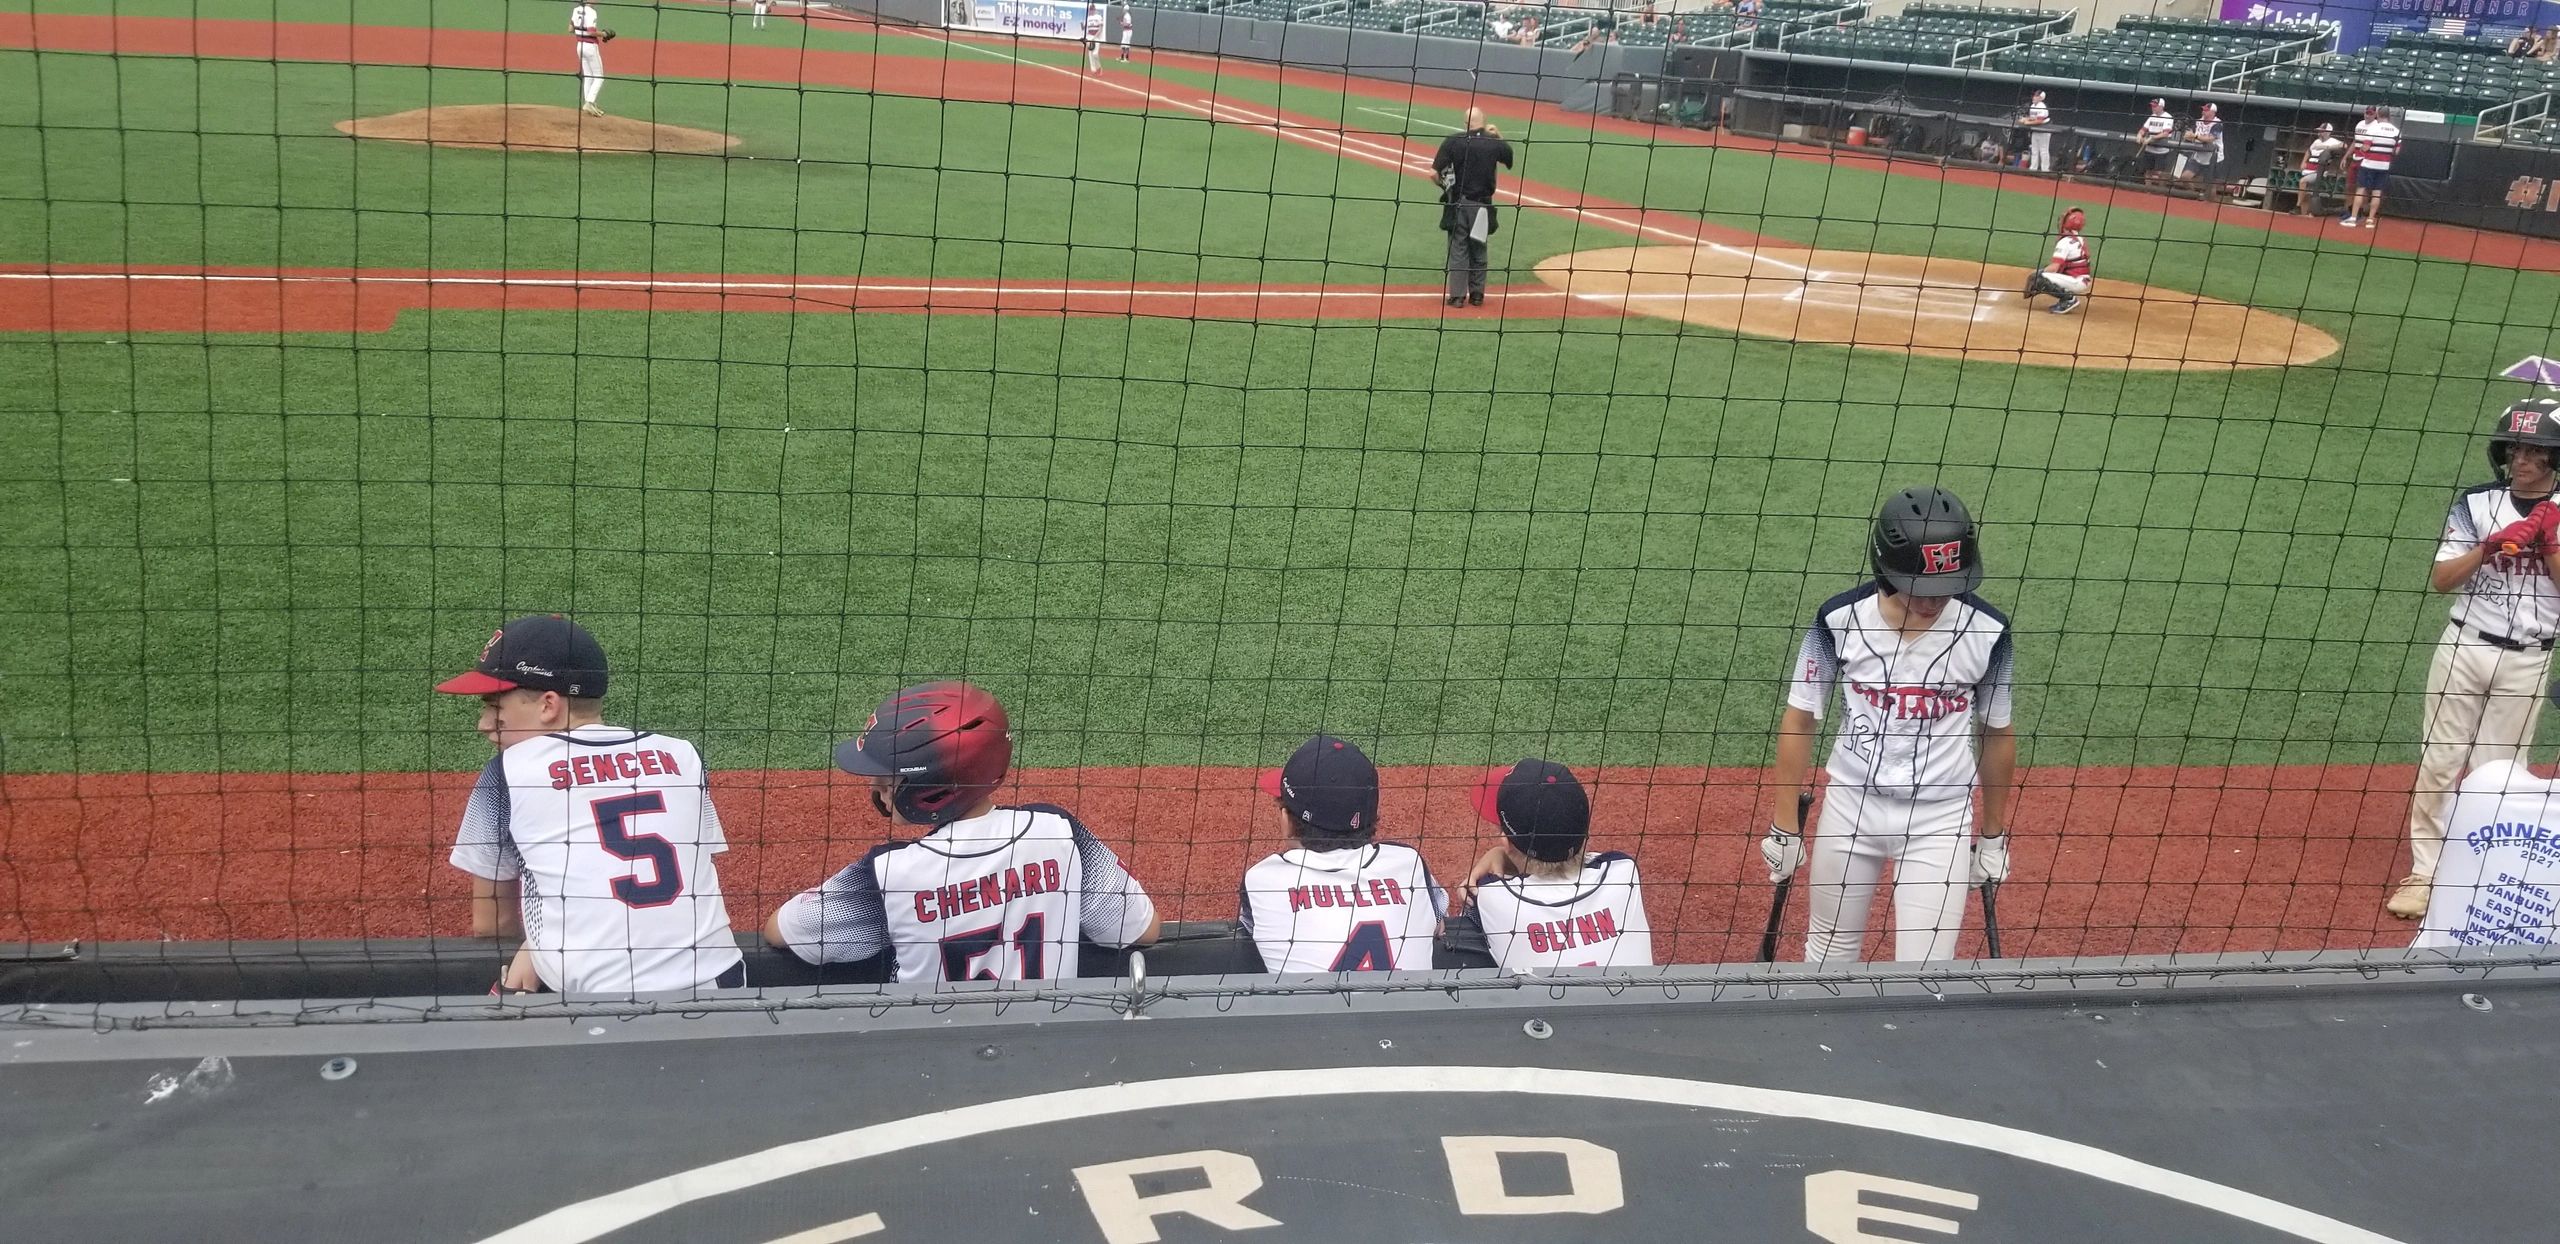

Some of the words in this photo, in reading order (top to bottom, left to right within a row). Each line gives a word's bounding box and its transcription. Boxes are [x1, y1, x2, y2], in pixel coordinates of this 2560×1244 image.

[998, 2, 1029, 15] Think
[1032, 4, 1045, 15] of
[1047, 5, 1056, 17] it
[1059, 10, 1072, 19] as
[2460, 0, 2530, 16] HONOR
[1023, 20, 1066, 34] money!
[1921, 540, 1961, 574] FC
[549, 750, 681, 790] SENCEN
[590, 790, 684, 909] 5
[2474, 838, 2510, 856] STATE
[2514, 839, 2560, 862] CHAMP
[914, 859, 1060, 923] CHENARD
[1288, 878, 1407, 913] MULLER
[2486, 882, 2555, 917] DANBURY
[1527, 907, 1618, 953] GLYNN
[2465, 904, 2494, 924] NEW
[2496, 919, 2558, 945] CANAA
[2486, 898, 2543, 929] EASTON
[2469, 922, 2525, 945] NEWTO
